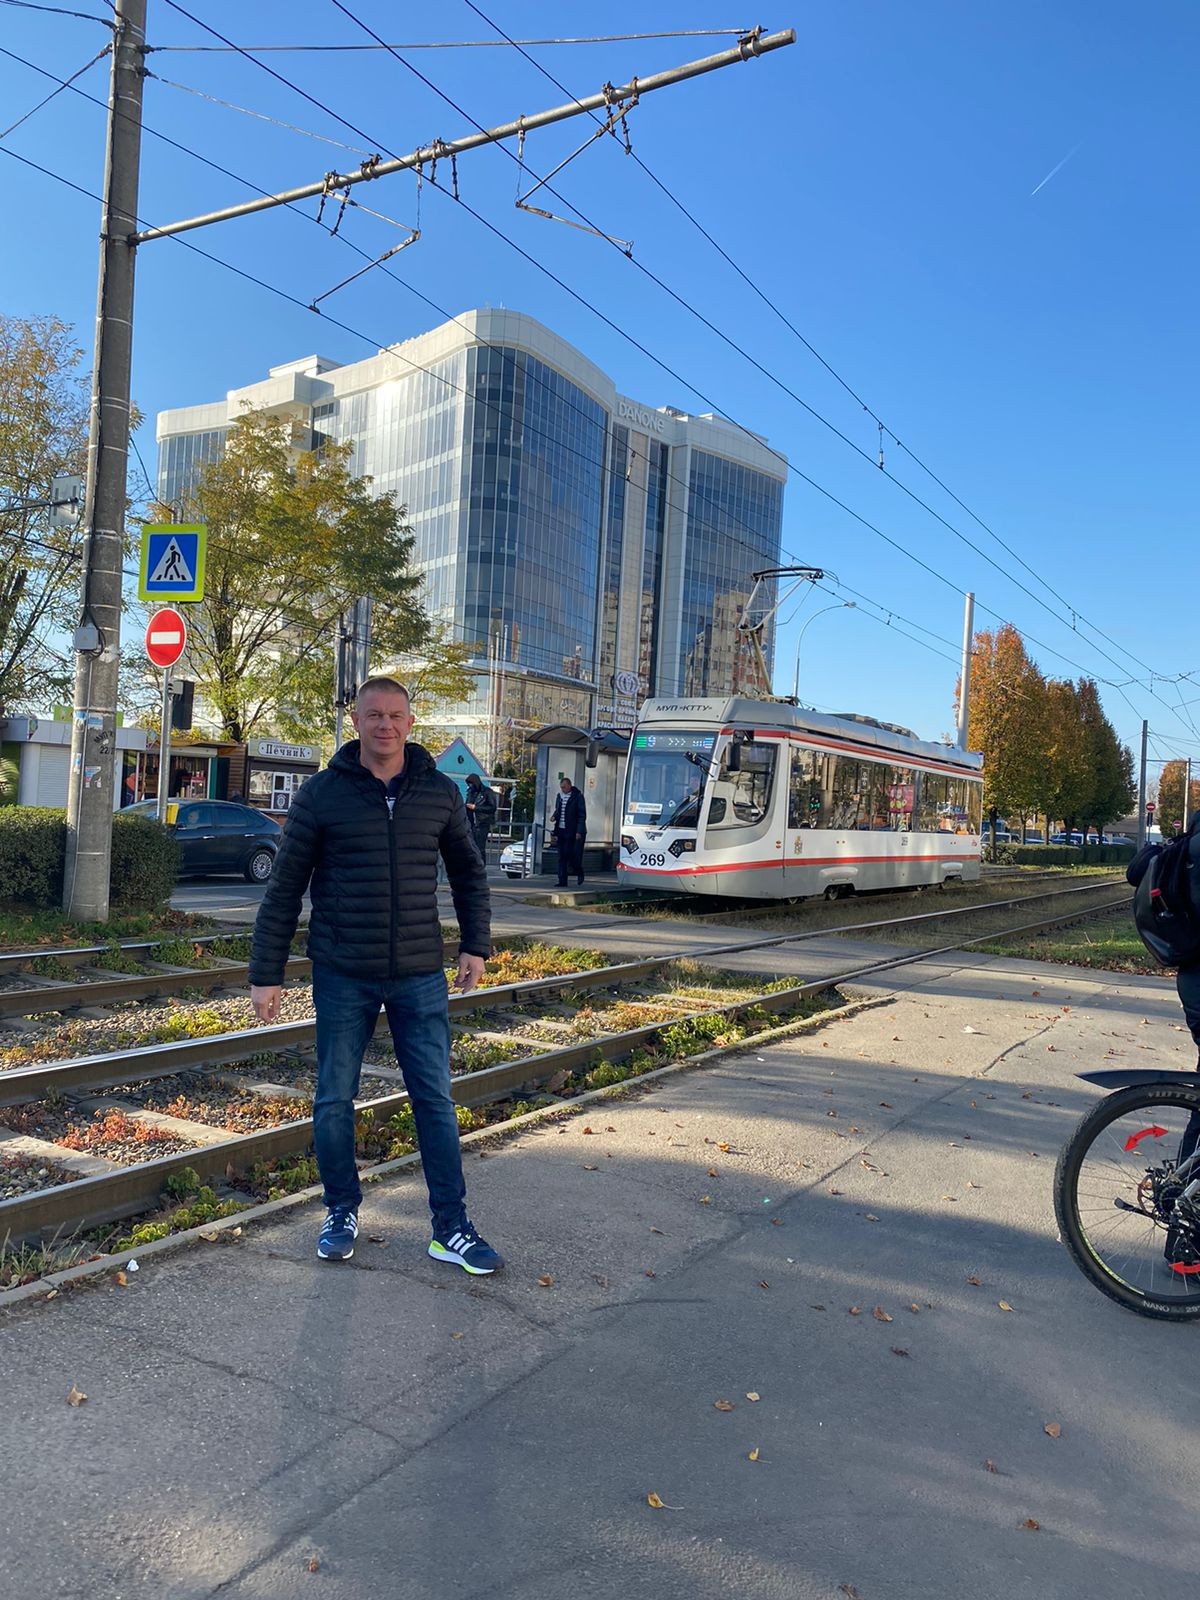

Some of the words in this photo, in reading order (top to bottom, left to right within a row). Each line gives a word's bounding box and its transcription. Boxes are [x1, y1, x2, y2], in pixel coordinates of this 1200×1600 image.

[656, 704, 678, 712] МУП
[640, 853, 666, 867] 269
[1143, 1300, 1169, 1313] NANO
